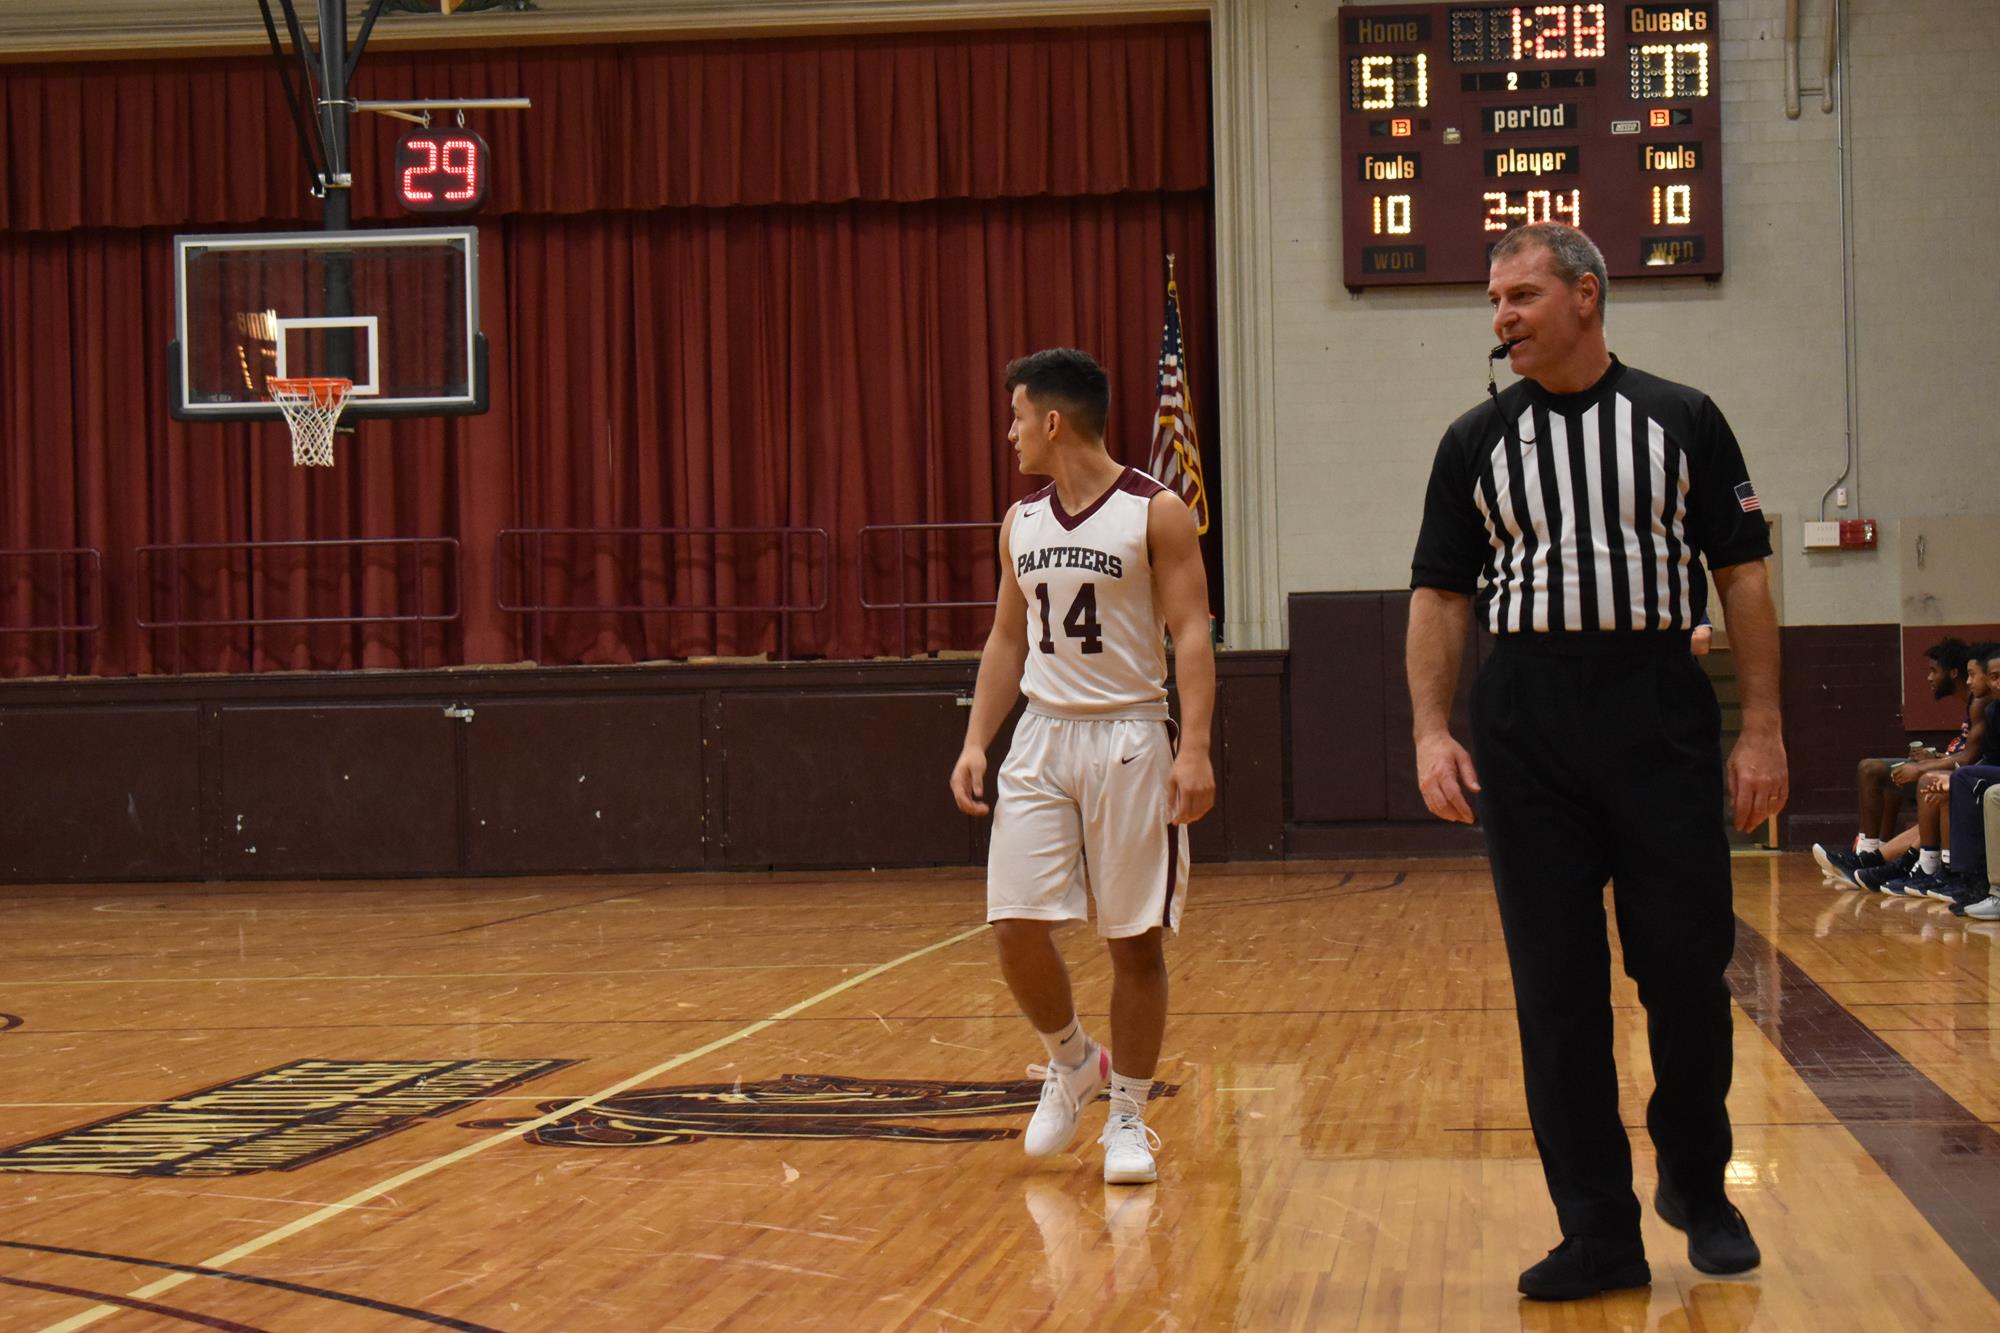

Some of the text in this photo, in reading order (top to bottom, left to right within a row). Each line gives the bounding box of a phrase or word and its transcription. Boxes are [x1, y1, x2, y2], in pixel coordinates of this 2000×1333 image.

[1358, 19, 1419, 43] Home
[1512, 4, 1605, 60] 1:28
[1631, 7, 1707, 33] Guests
[1362, 53, 1428, 109] 51
[1506, 71, 1519, 91] 2
[1541, 72, 1550, 89] 3
[1575, 70, 1585, 87] 4
[1641, 42, 1708, 98] 77
[1494, 103, 1565, 133] period
[403, 140, 478, 202] 29
[1365, 154, 1416, 181] fouls
[1496, 148, 1567, 177] player
[1645, 145, 1696, 171] fouls
[1373, 194, 1412, 235] 10
[1652, 184, 1692, 225] 10
[1374, 252, 1415, 270] won
[1652, 241, 1693, 263] won
[1017, 546, 1123, 579] PANTHERS
[1035, 582, 1104, 655] 14
